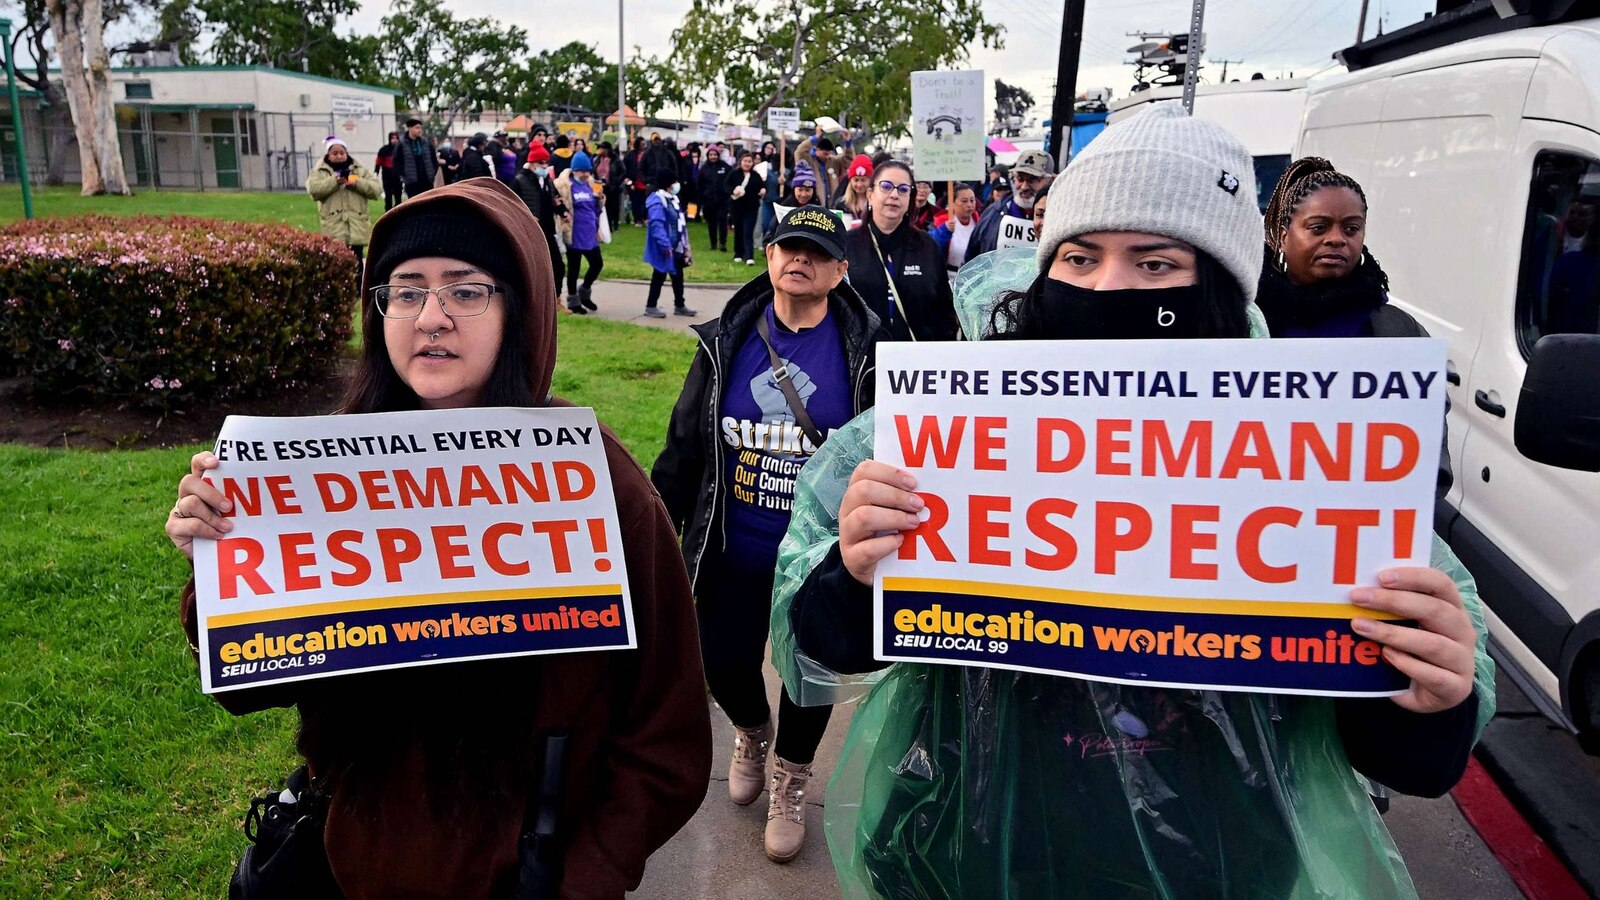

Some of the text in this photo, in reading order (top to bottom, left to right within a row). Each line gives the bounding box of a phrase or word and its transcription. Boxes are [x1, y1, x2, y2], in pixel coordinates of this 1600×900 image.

[919, 77, 947, 88] Don't
[953, 75, 964, 85] be
[1005, 223, 1024, 241] ON
[1157, 306, 1176, 327] b
[888, 370, 1438, 400] WE'RE ESSENTIAL EVERY DAY
[214, 426, 593, 462] E'RE ESSENTIAL EVERY DAY
[895, 414, 1421, 483] WE DEMAND
[203, 459, 597, 518] WE DEMAND
[734, 484, 755, 505] Our
[735, 465, 797, 494] Our Contr
[896, 492, 1418, 586] RESPECT!
[217, 517, 612, 600] RESPECT!
[220, 604, 621, 663] education workers united
[893, 604, 1389, 666] education workers unite
[894, 633, 1009, 655] SEIU LOCAL 99
[221, 653, 326, 678] SEIU LOCAL 99
